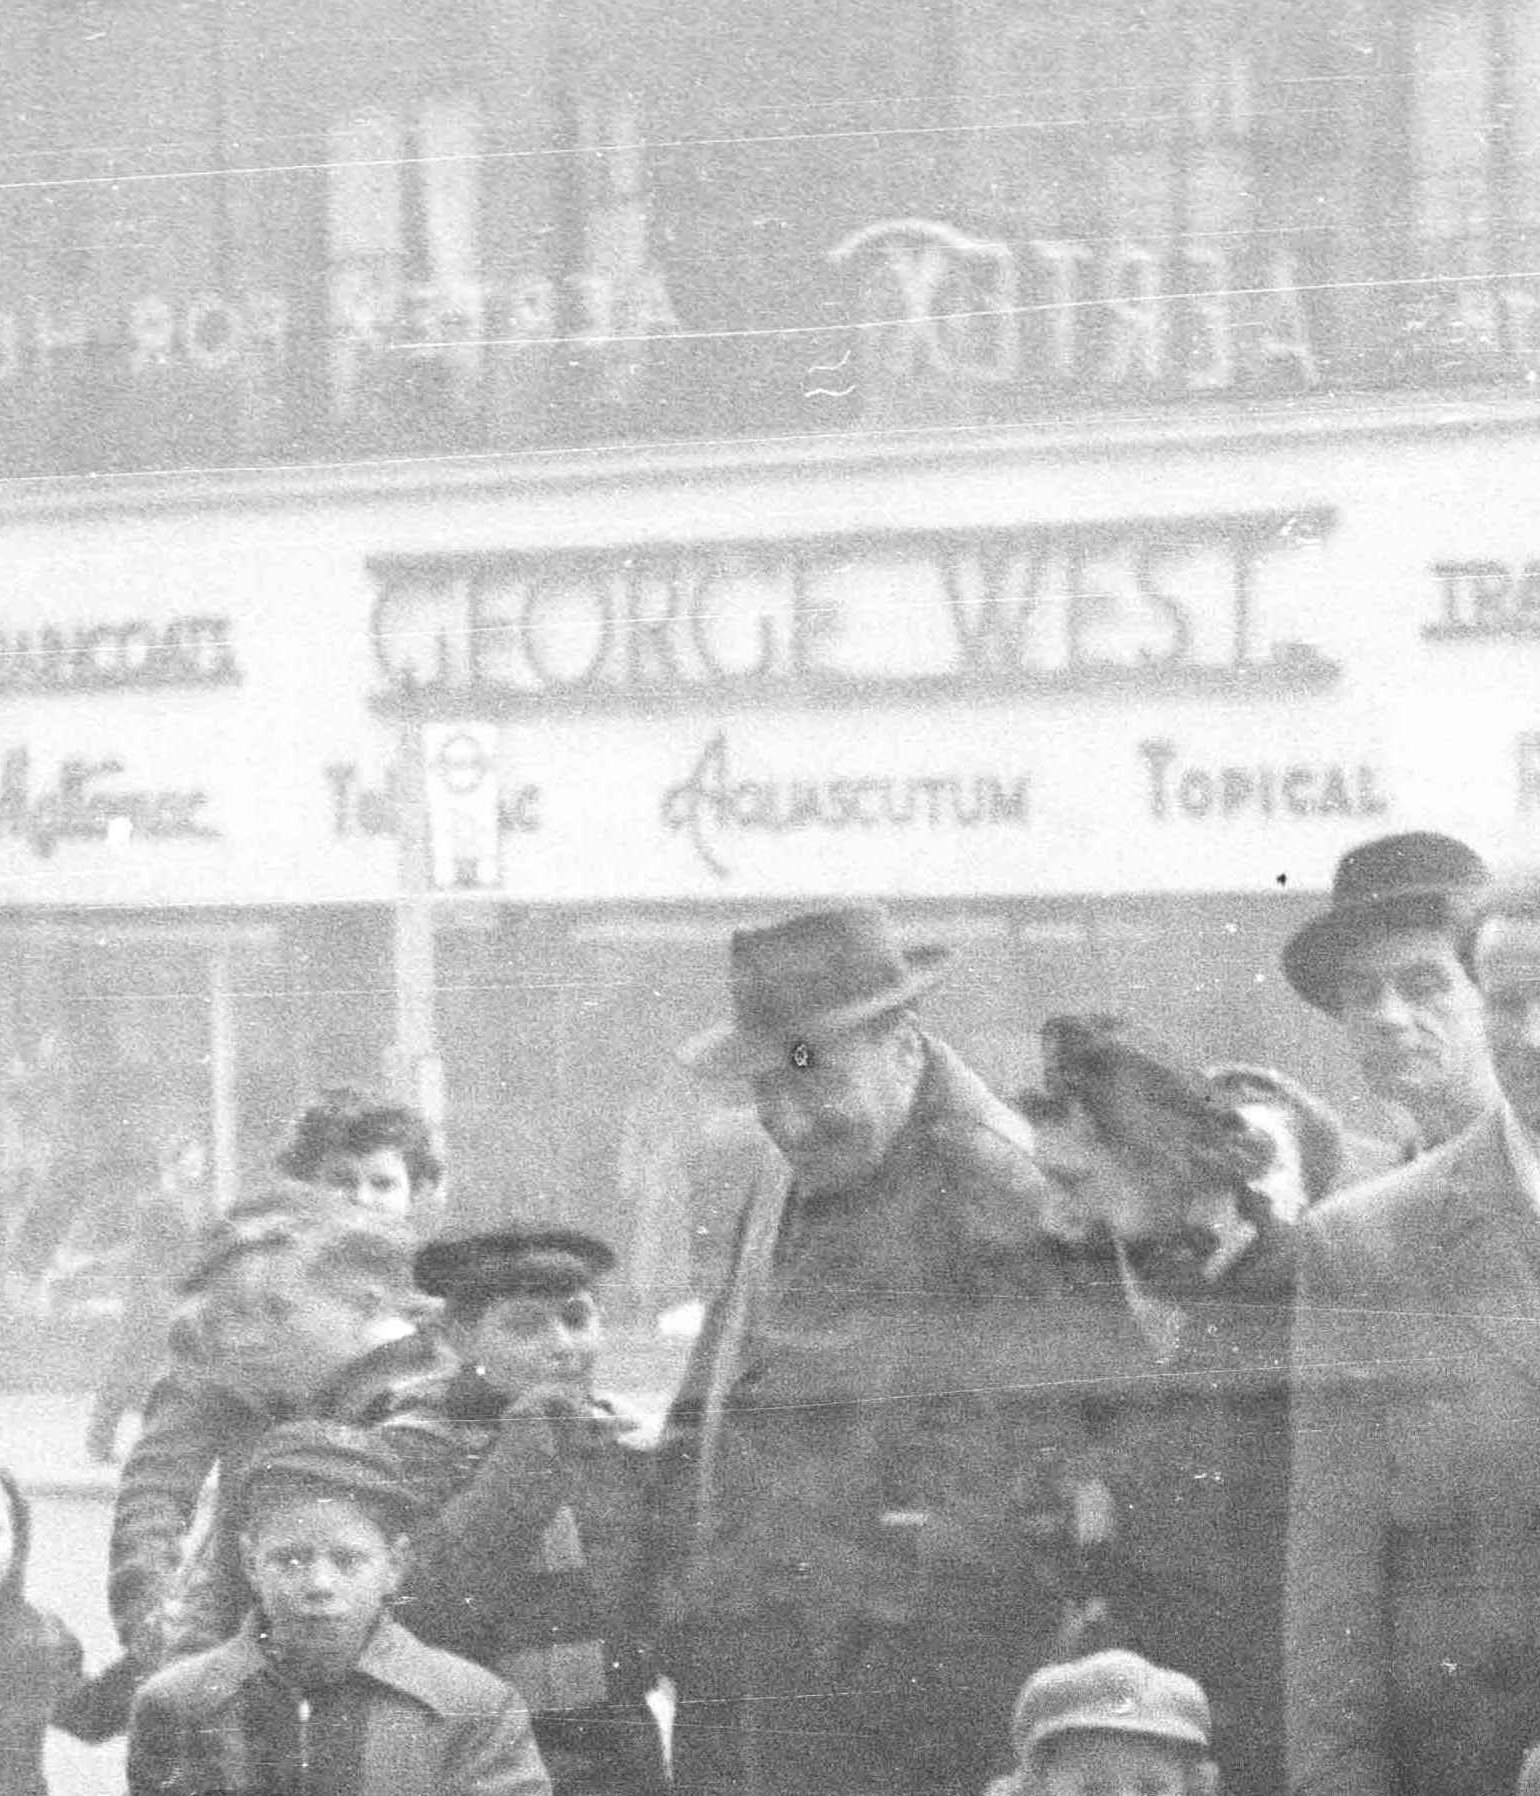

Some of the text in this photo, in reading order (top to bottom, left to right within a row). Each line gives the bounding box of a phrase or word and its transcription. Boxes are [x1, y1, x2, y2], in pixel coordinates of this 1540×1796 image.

[368, 530, 1286, 692] GEORGE WEST
[1138, 738, 1387, 821] TOPICAL
